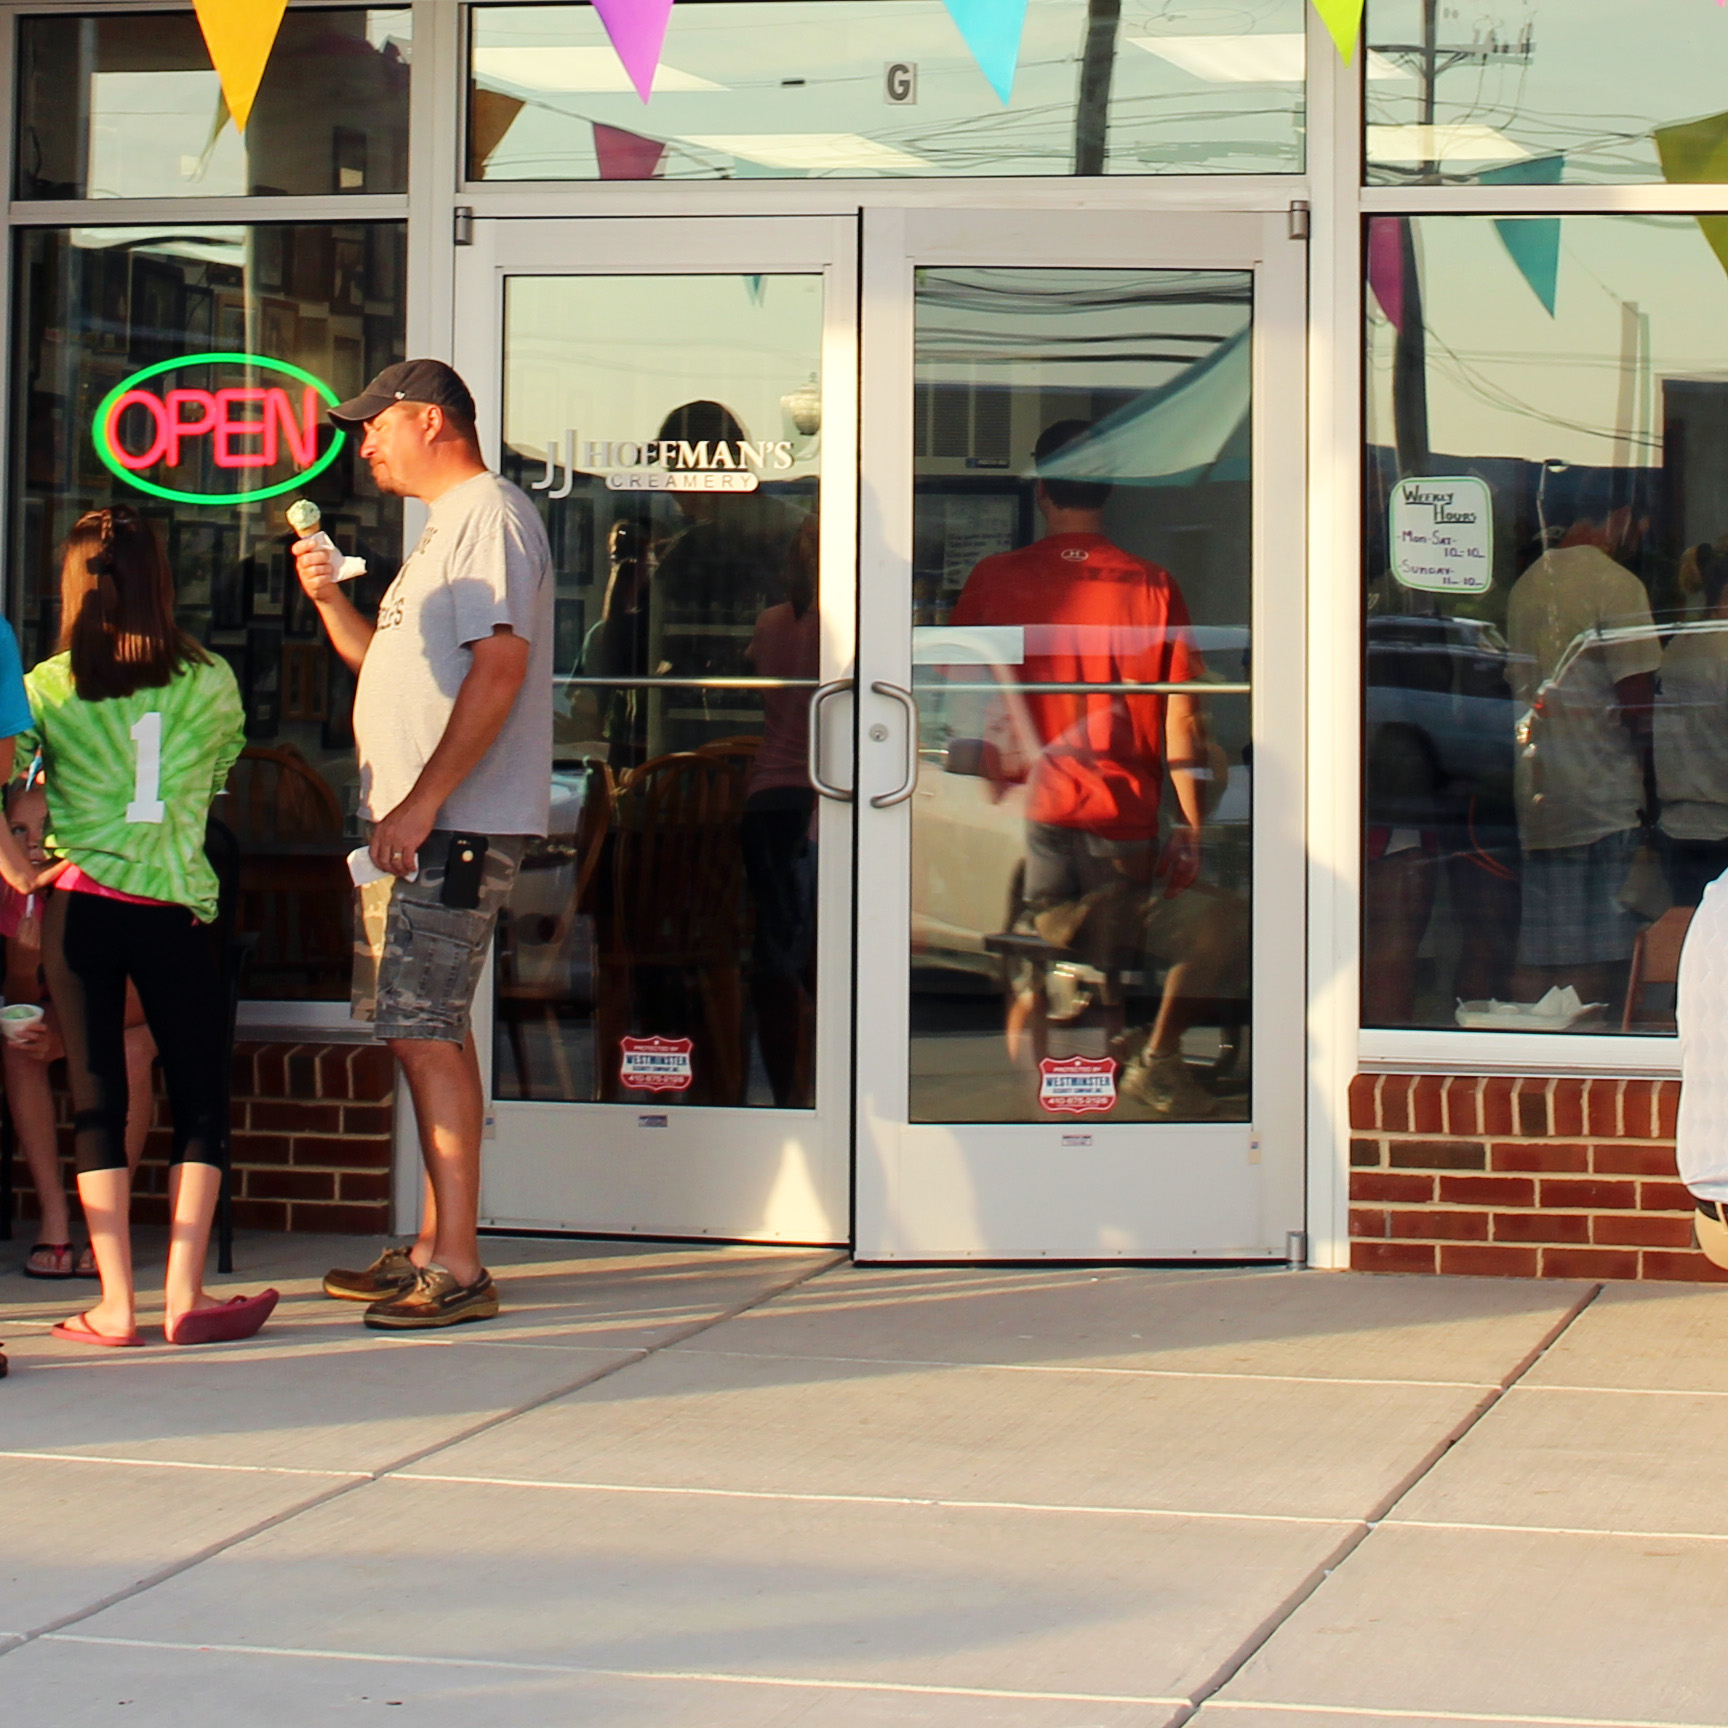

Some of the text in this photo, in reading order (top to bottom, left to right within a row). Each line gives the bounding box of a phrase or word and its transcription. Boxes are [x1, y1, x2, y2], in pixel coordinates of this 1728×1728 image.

[887, 63, 911, 101] G
[104, 386, 319, 470] OPEN
[531, 429, 795, 499] JJ HOFFMAN'S
[610, 474, 753, 488] CREAMERY
[126, 711, 165, 824] 1
